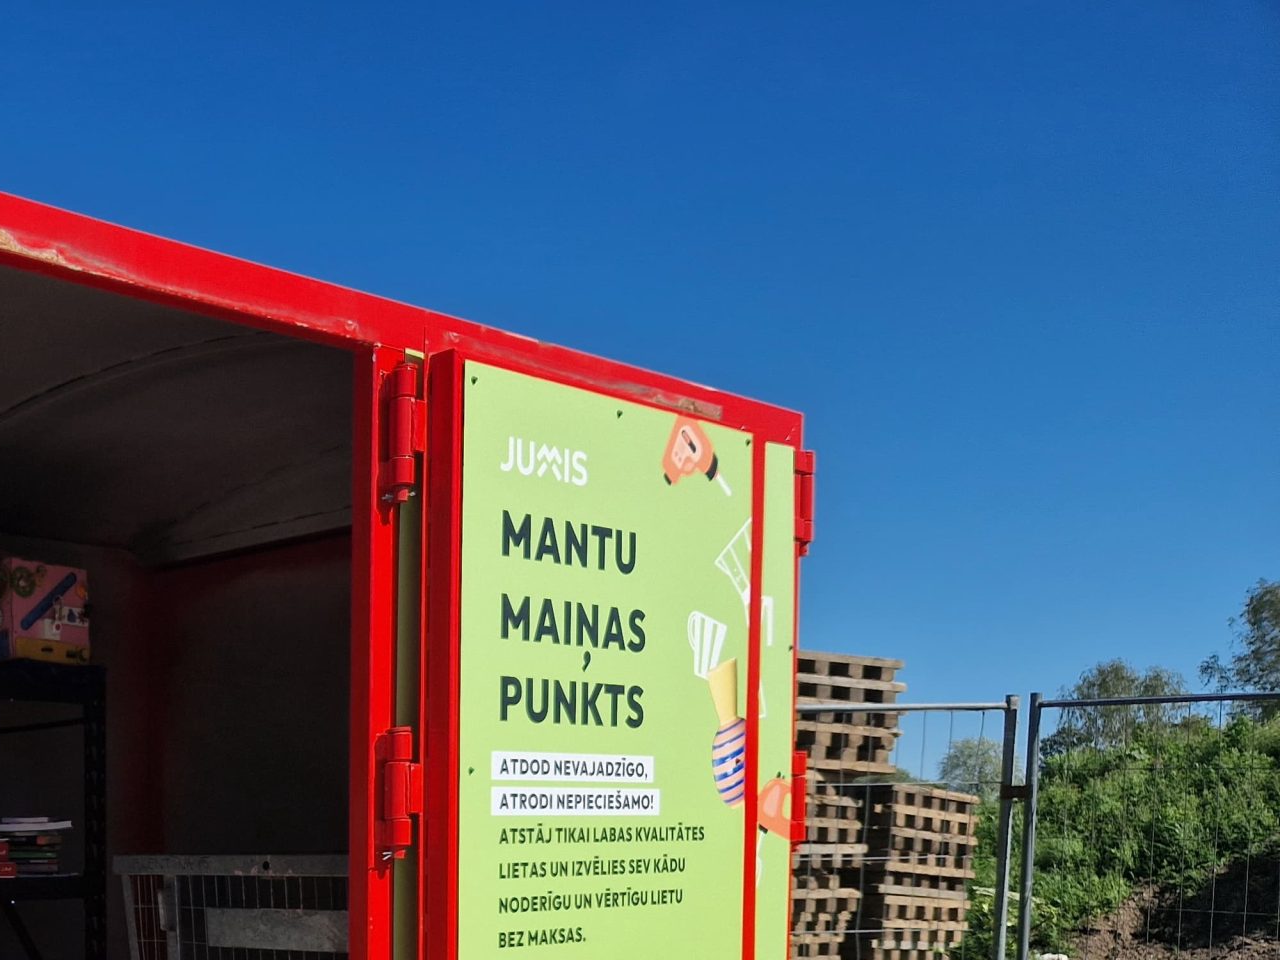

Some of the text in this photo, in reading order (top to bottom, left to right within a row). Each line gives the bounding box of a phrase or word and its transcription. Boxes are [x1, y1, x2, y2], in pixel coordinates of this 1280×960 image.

[500, 436, 588, 486] JUMIS
[501, 509, 637, 575] MANTU
[500, 593, 646, 672] MAIŅAS
[499, 675, 644, 729] PUNKTS
[500, 757, 648, 780] ATDOD NEVAJADZĪGO,
[499, 790, 654, 809] ATRODI NEPIECIEŠAMO!
[499, 822, 705, 844] ATSTĀJ TIKAI LABAS KVALITĀTES
[499, 854, 686, 879] LIETAS UN IZVĒLIES SEV KĀDU
[499, 887, 683, 914] NODERĪGU UN VĒRTĪGU LIETU
[498, 926, 586, 948] BEZ MAKSAS.
